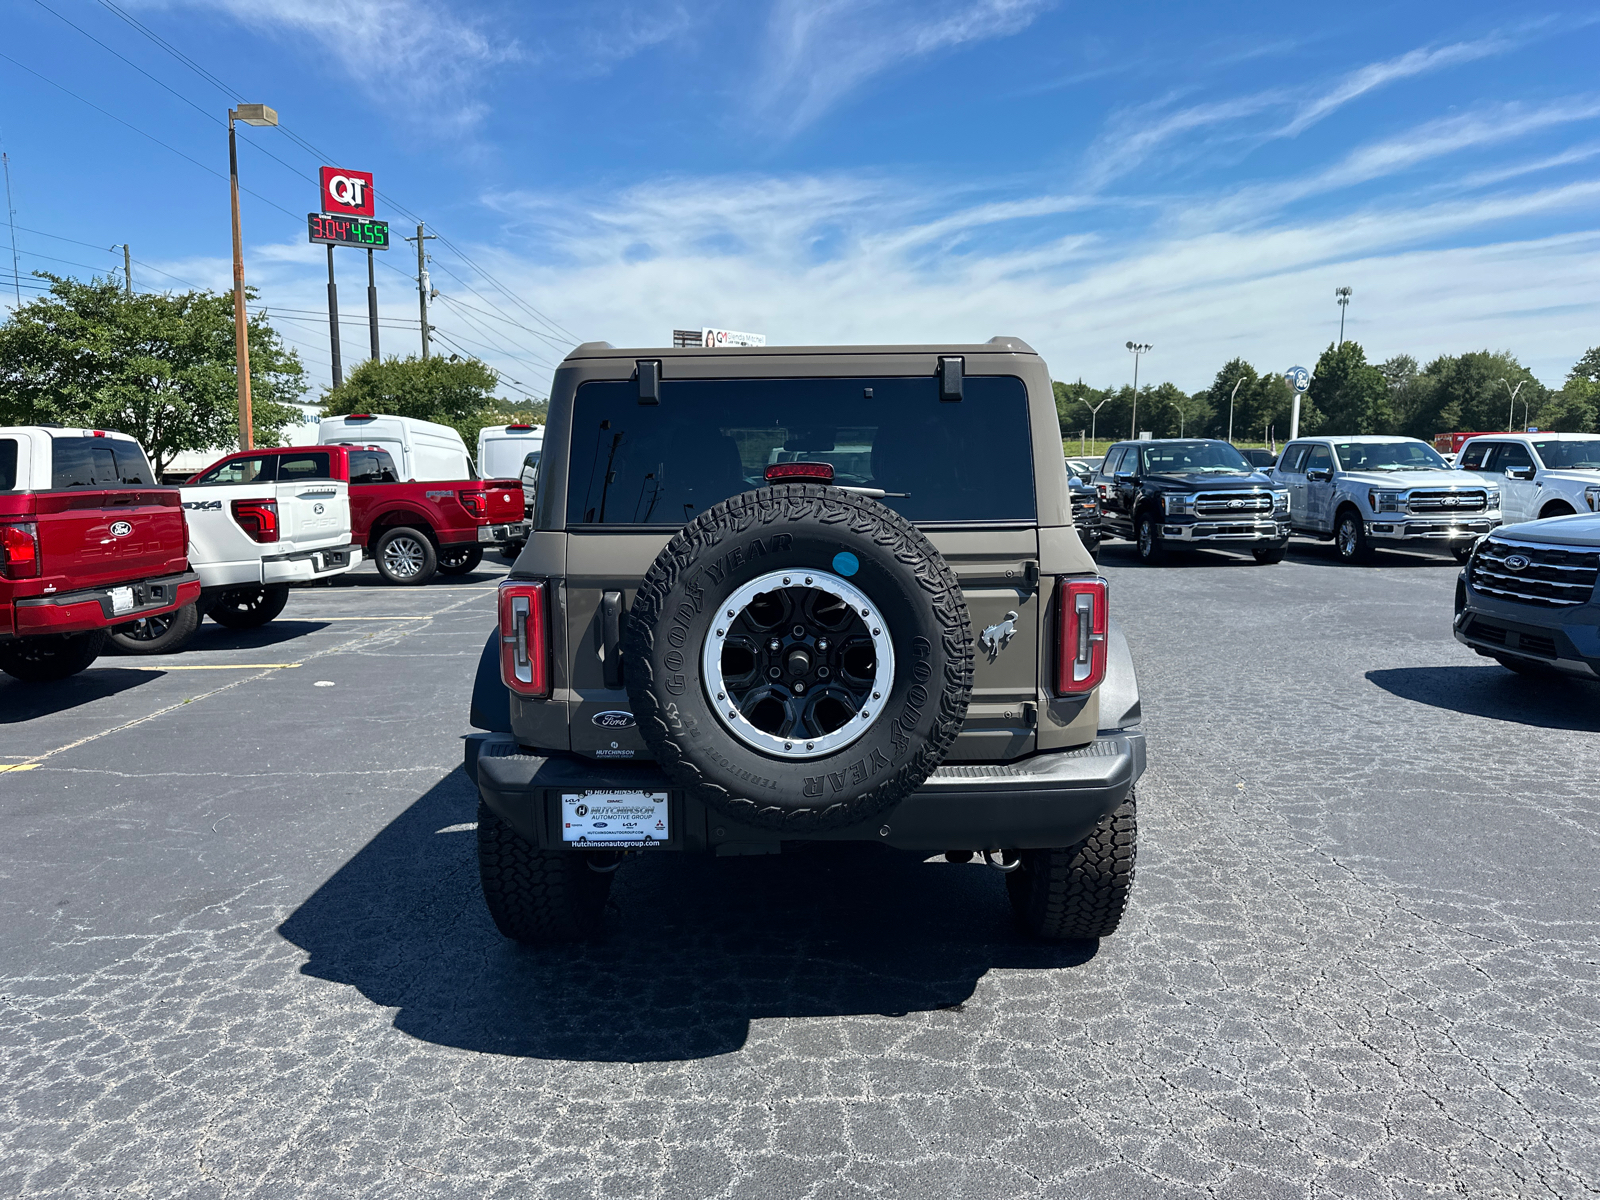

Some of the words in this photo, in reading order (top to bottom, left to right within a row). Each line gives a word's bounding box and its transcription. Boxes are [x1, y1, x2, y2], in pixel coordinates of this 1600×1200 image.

[329, 175, 366, 207] QT
[1296, 371, 1309, 388] Ford
[112, 522, 130, 536] Ford
[1507, 557, 1522, 567] Ford
[601, 714, 628, 726] Ford
[590, 806, 655, 815] HUTCHINSON
[572, 840, 660, 848] Hutchinsonautogroup.com
